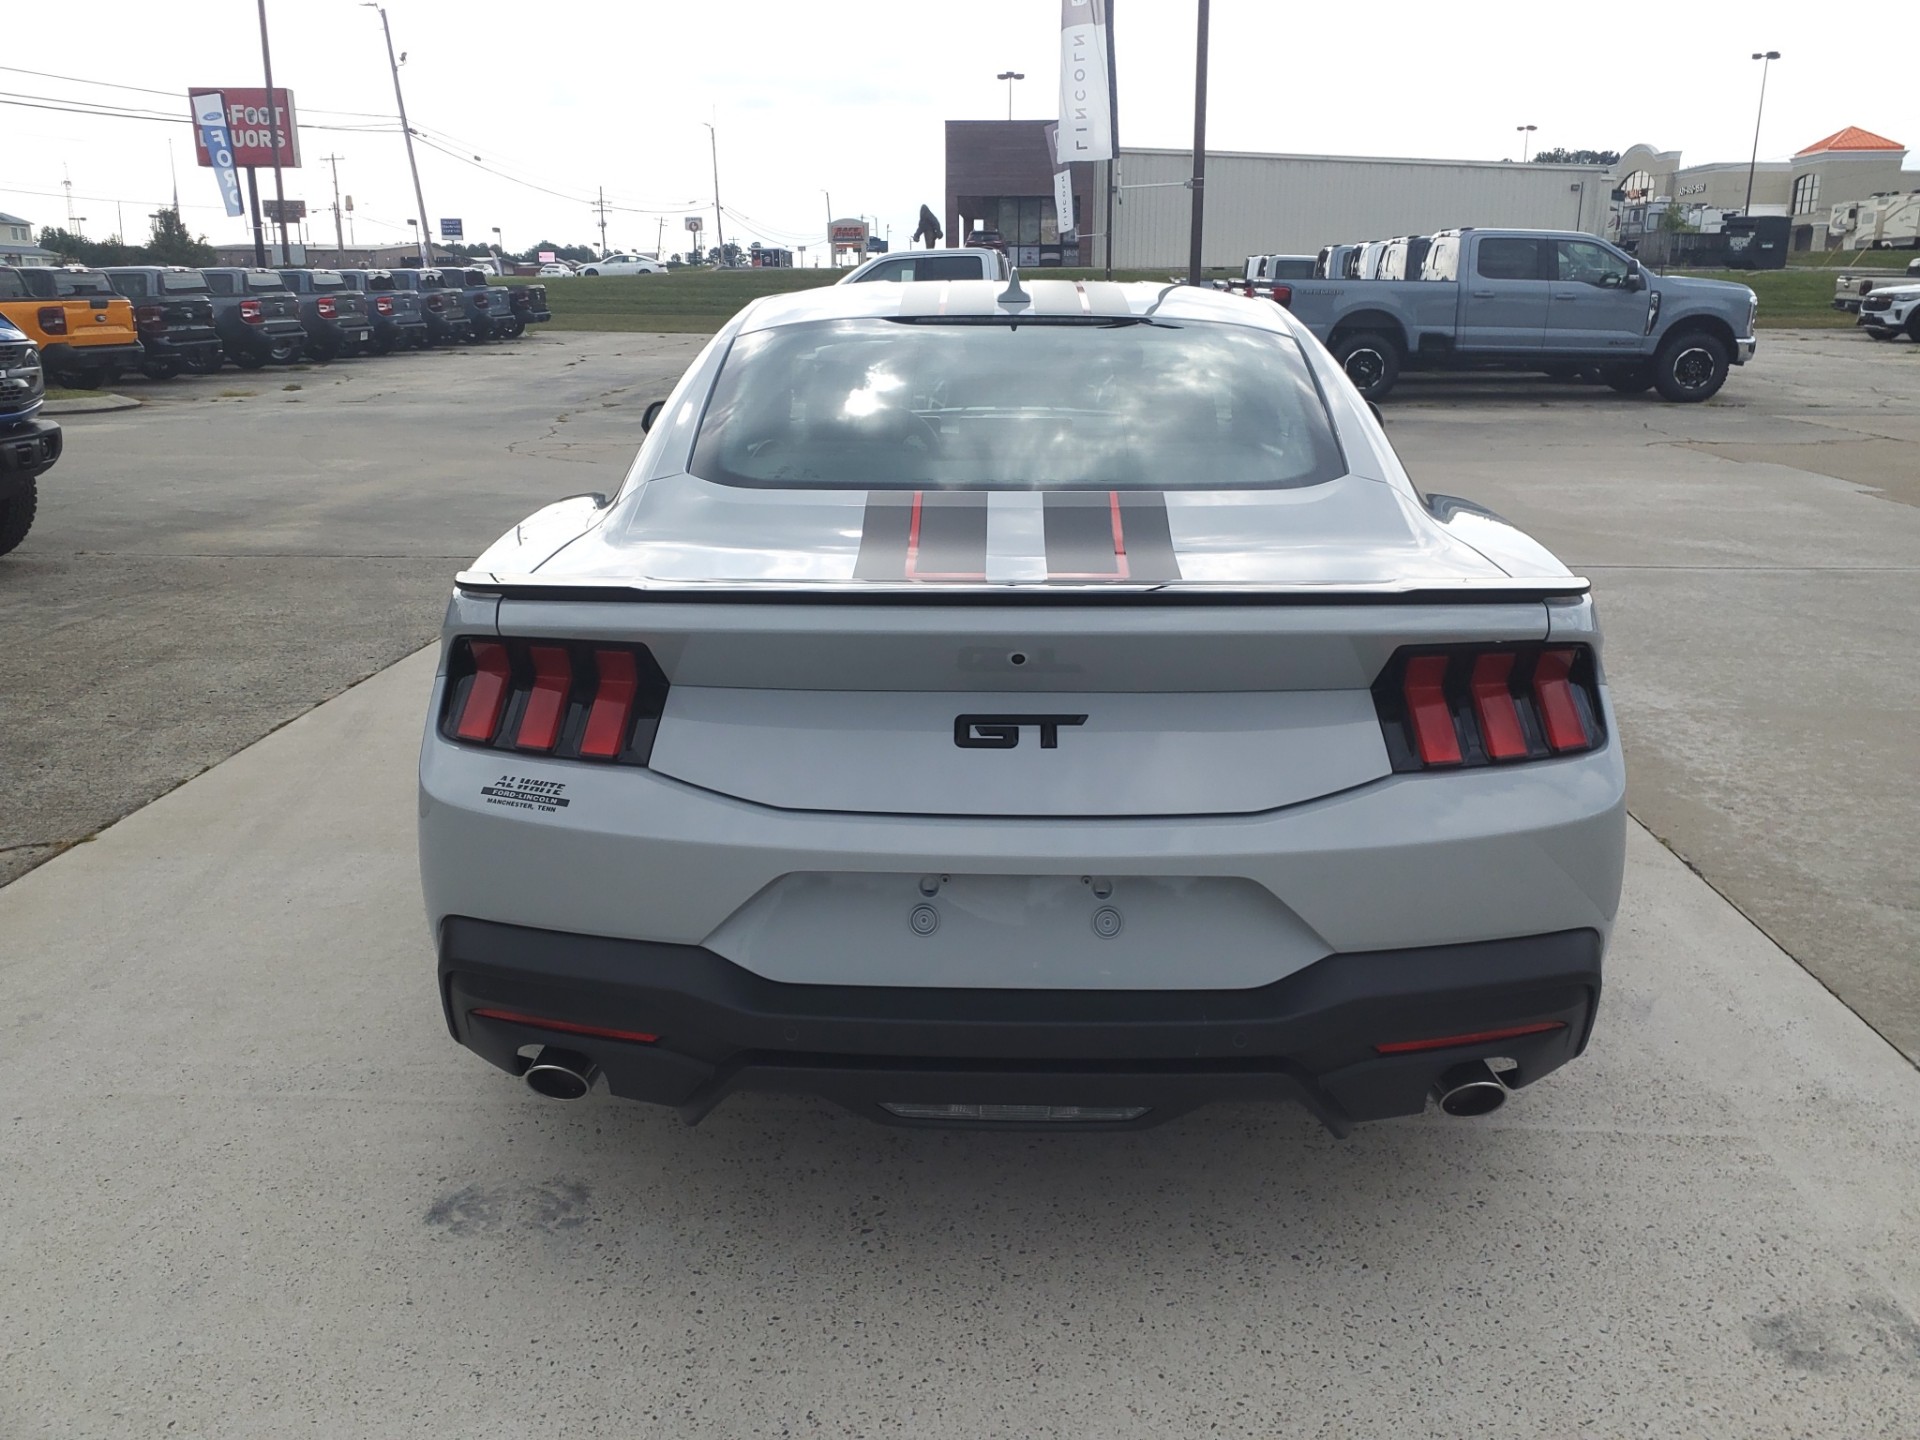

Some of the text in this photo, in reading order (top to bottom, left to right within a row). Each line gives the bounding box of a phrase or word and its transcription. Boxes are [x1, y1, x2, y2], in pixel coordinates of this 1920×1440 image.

[227, 104, 284, 126] FOOT
[198, 129, 286, 148] LUORS
[954, 714, 1089, 749] GT
[486, 797, 557, 812] MANCHESTER, TENN
[491, 789, 558, 804] FORD-LINCOLN
